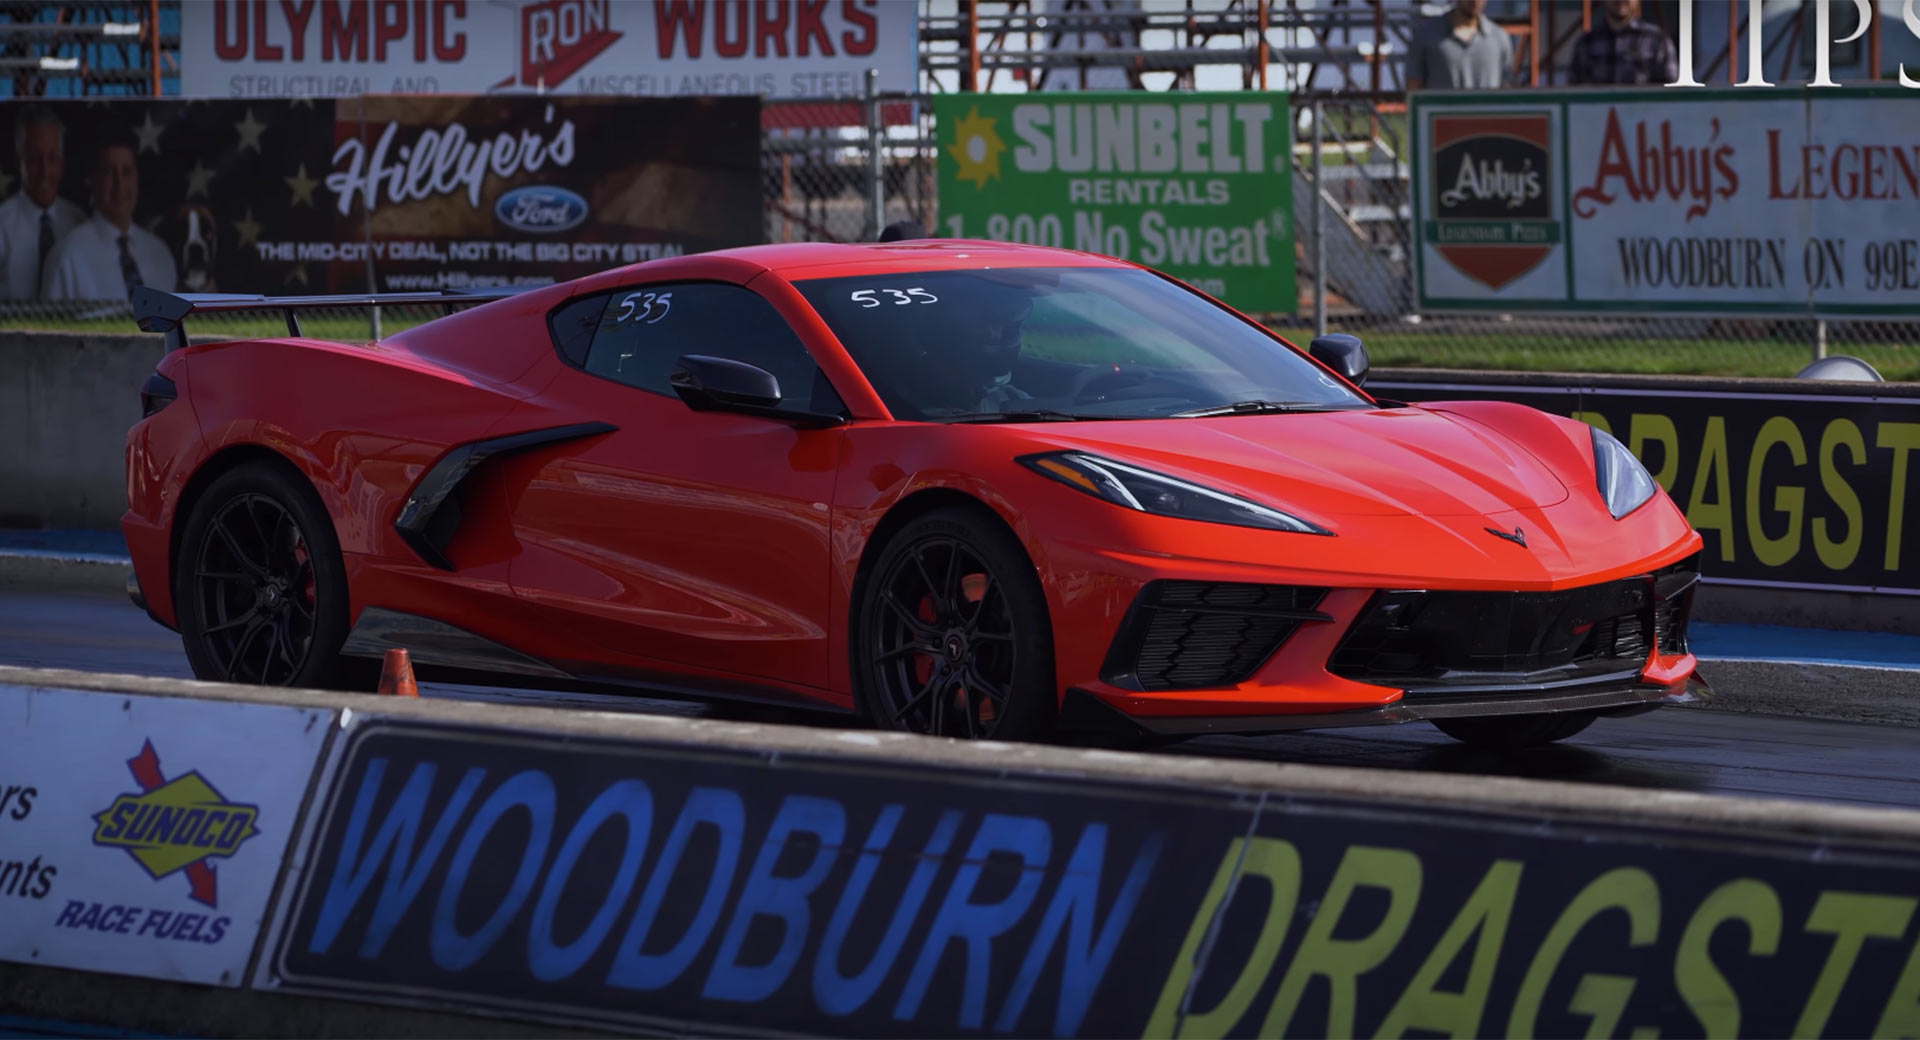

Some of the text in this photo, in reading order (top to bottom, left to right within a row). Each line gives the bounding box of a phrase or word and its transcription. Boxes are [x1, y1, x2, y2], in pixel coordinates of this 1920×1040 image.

[214, 0, 466, 62] OLYMPIC
[653, 0, 876, 59] WORKS
[229, 72, 862, 97] STRUCTURAL AND MISCELLANEOUS STEEL
[325, 103, 576, 217] Hillyer's
[1012, 103, 1272, 173] SUNBELT
[1440, 152, 1542, 210] Abby's
[1572, 106, 1739, 223] Abby's
[511, 193, 571, 224] Ford
[1069, 180, 1230, 205] RENTALS
[257, 241, 295, 261] THE
[297, 241, 386, 261] MID-CITY
[388, 241, 448, 264] DEAL,
[449, 242, 490, 261] NOT
[497, 242, 533, 262] THE
[536, 243, 569, 262] BIG
[573, 243, 618, 262] CITY
[1074, 211, 1129, 259] No
[1617, 237, 1920, 291] WOODBURN ON 99E
[617, 292, 672, 324] 535
[850, 287, 938, 308] 535
[100, 801, 252, 850] SUNOCO
[0, 854, 57, 900] nts
[308, 757, 1920, 1040] WOODBURN DRAGST
[55, 900, 231, 945] RACE FUELS
